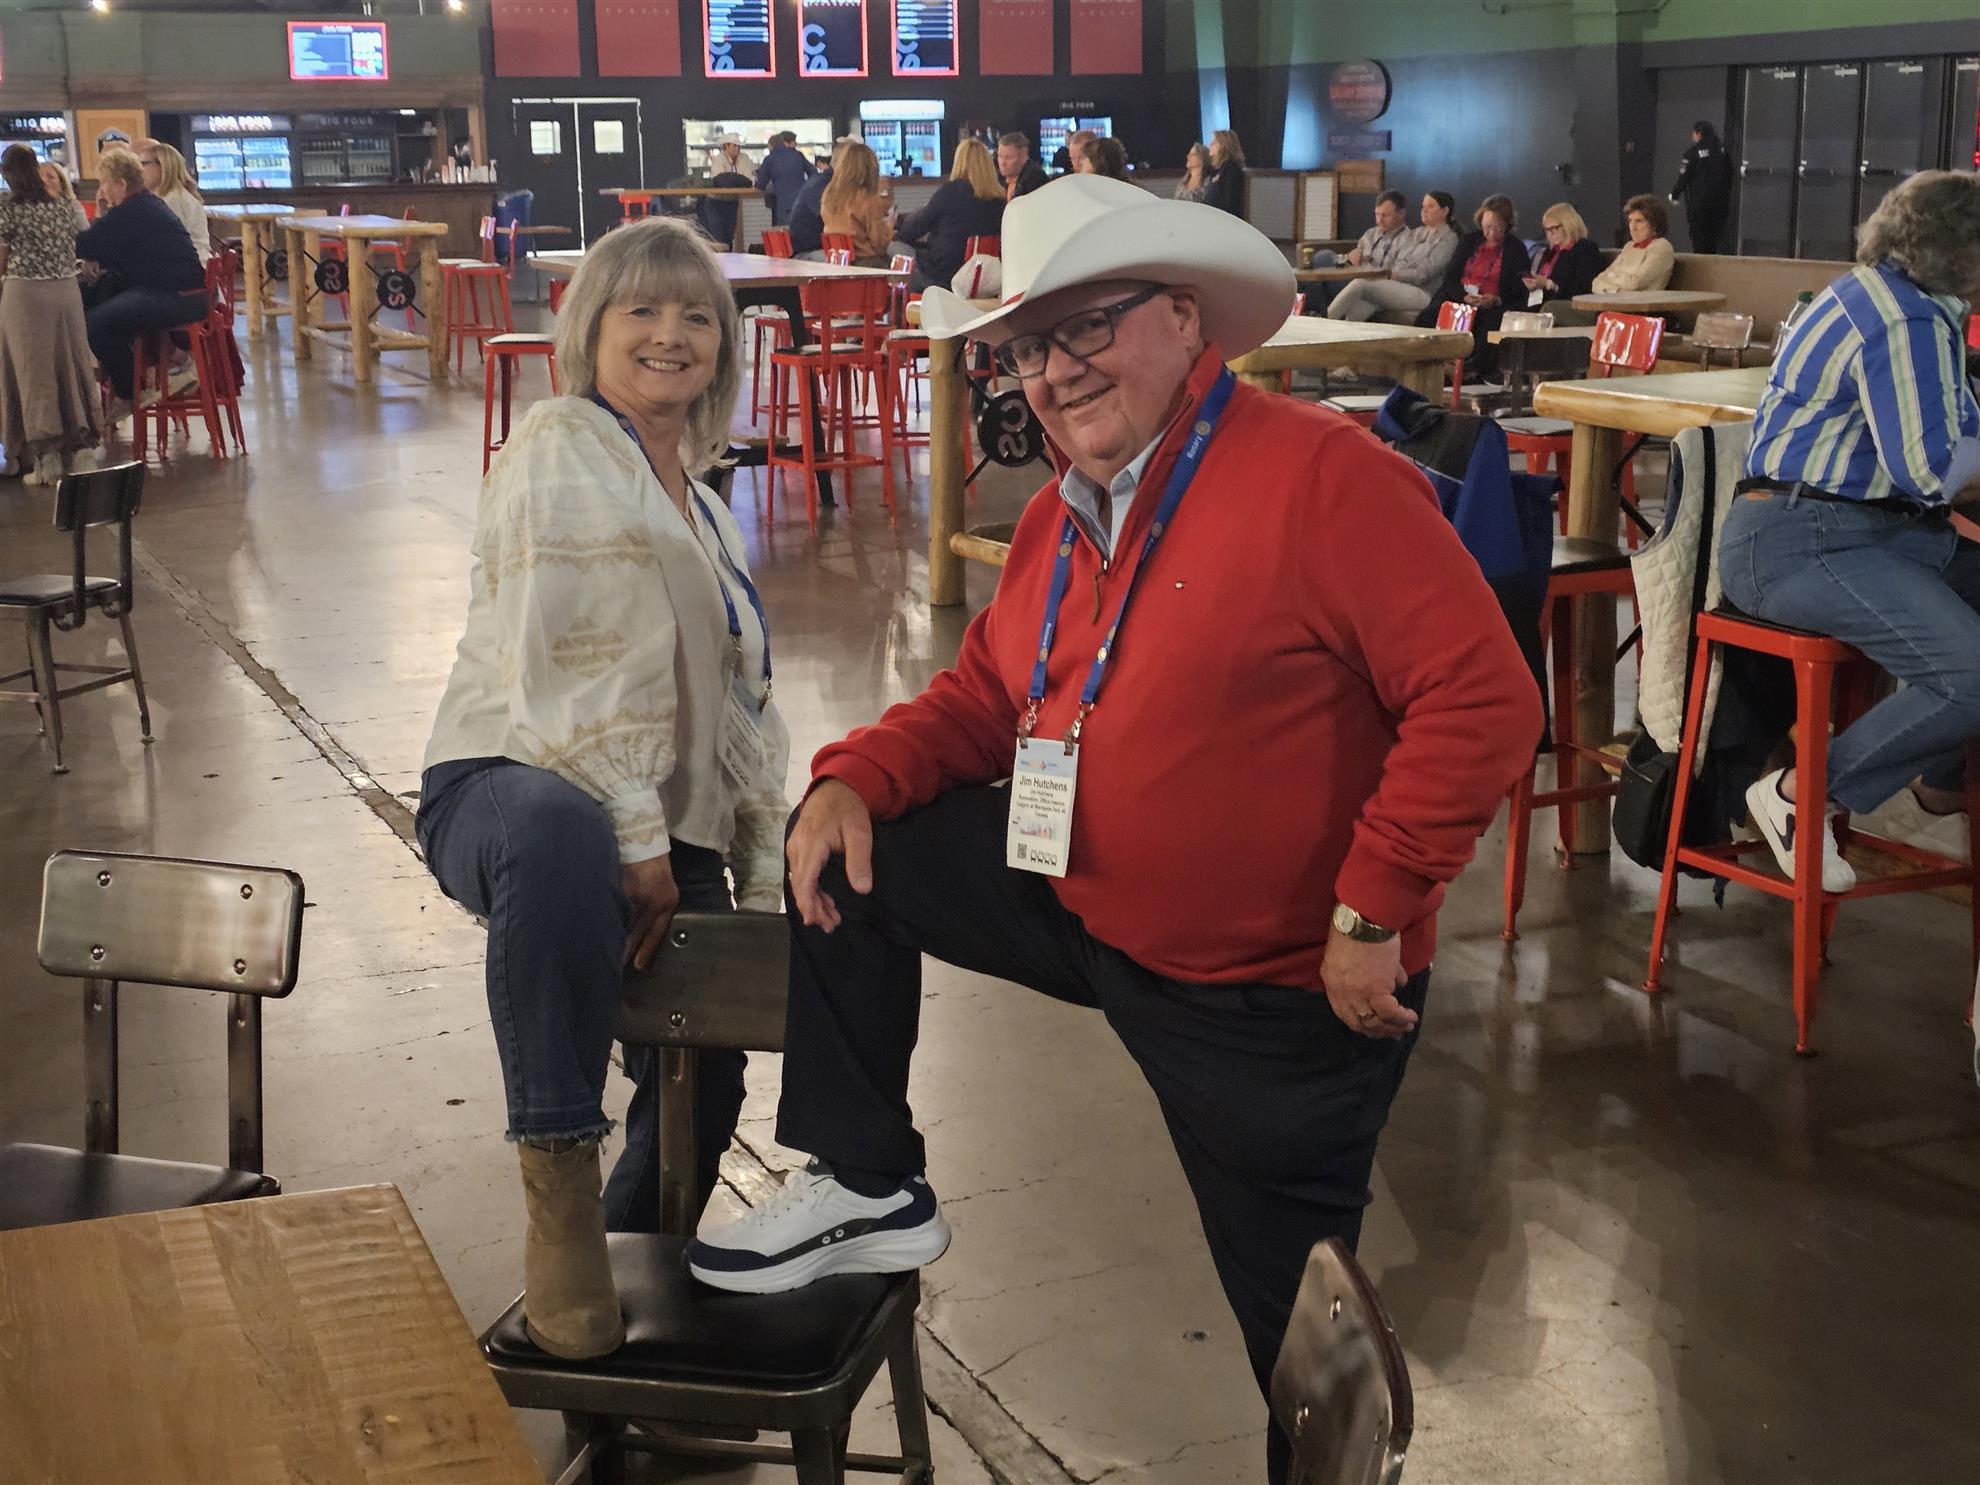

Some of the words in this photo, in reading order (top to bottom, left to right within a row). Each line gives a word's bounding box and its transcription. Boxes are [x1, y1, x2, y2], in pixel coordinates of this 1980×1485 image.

[320, 116, 340, 125] BIG
[343, 116, 373, 126] FOUR
[1019, 775, 1032, 787] Jim
[1033, 777, 1068, 792] Hutchens
